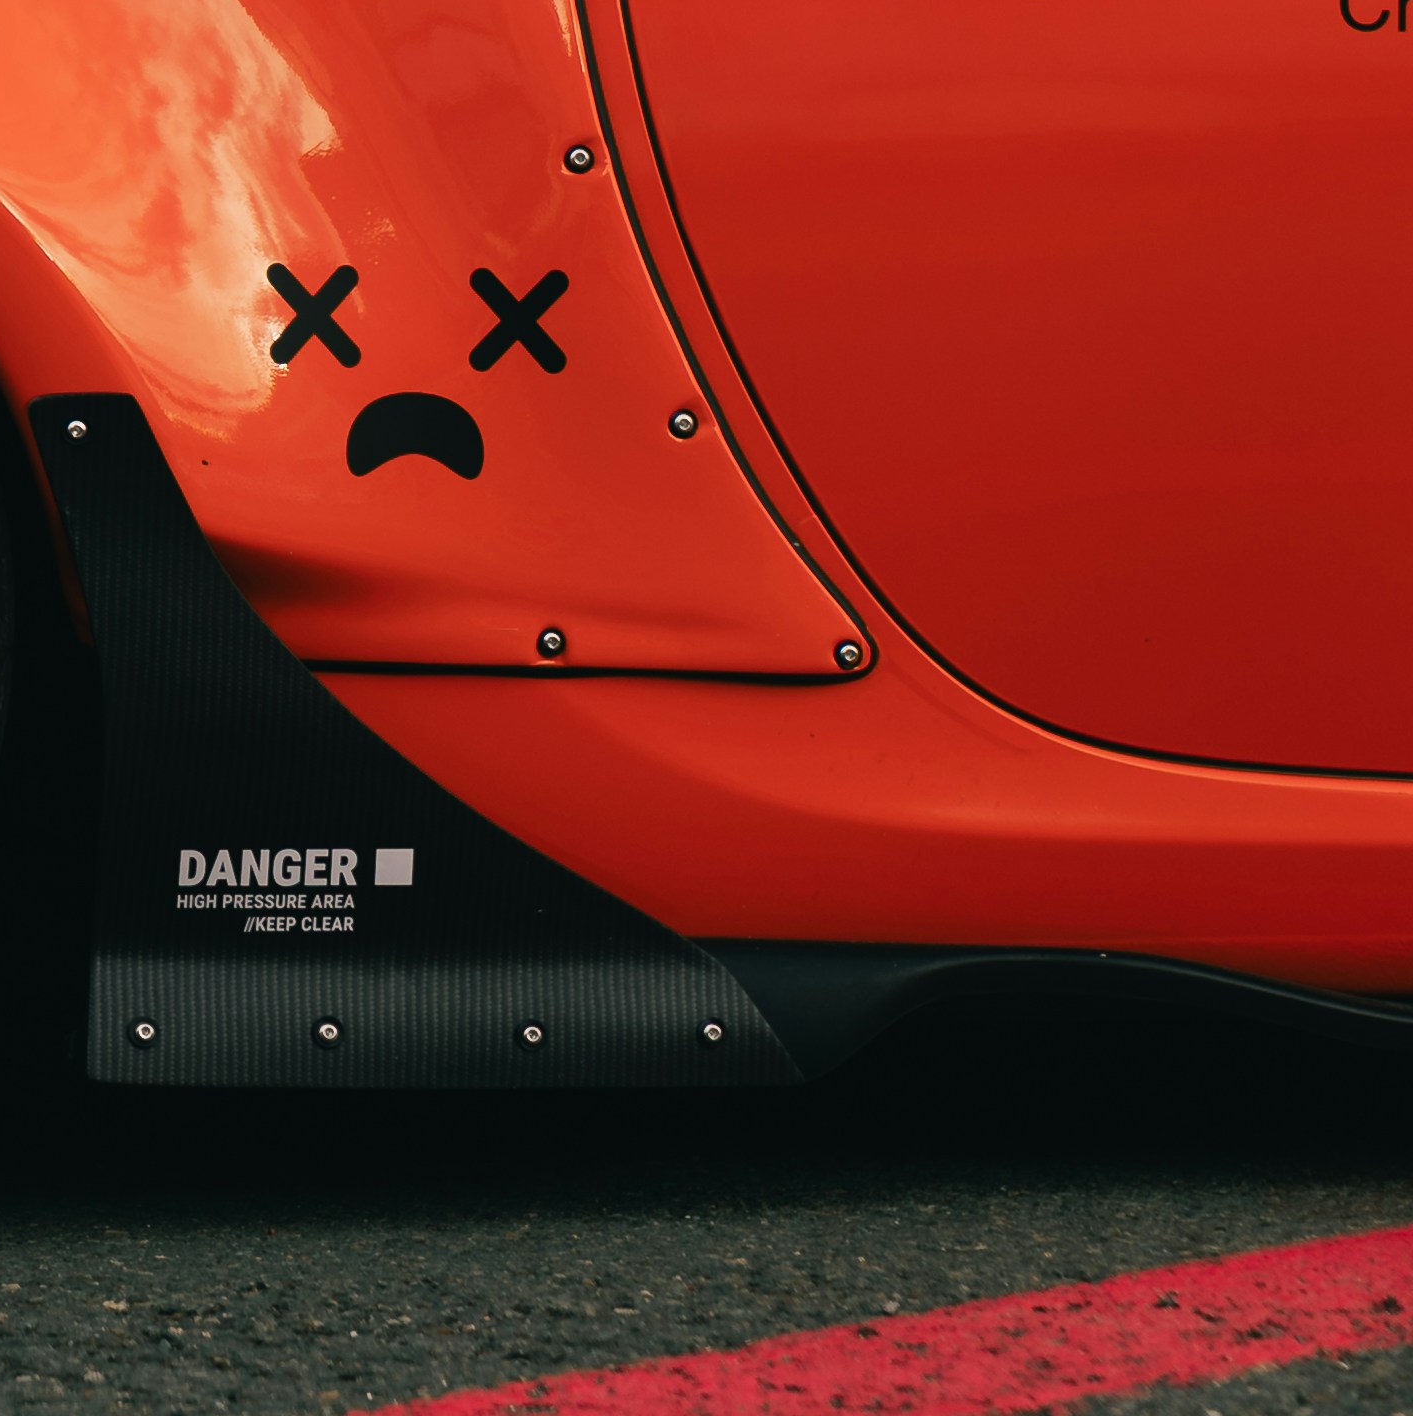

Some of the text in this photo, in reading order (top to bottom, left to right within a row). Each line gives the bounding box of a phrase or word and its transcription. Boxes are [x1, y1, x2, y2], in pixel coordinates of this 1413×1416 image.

[178, 848, 358, 886] DANGER
[176, 894, 355, 909] HIGH PRESSURE AREA
[301, 916, 354, 932] CLEAR
